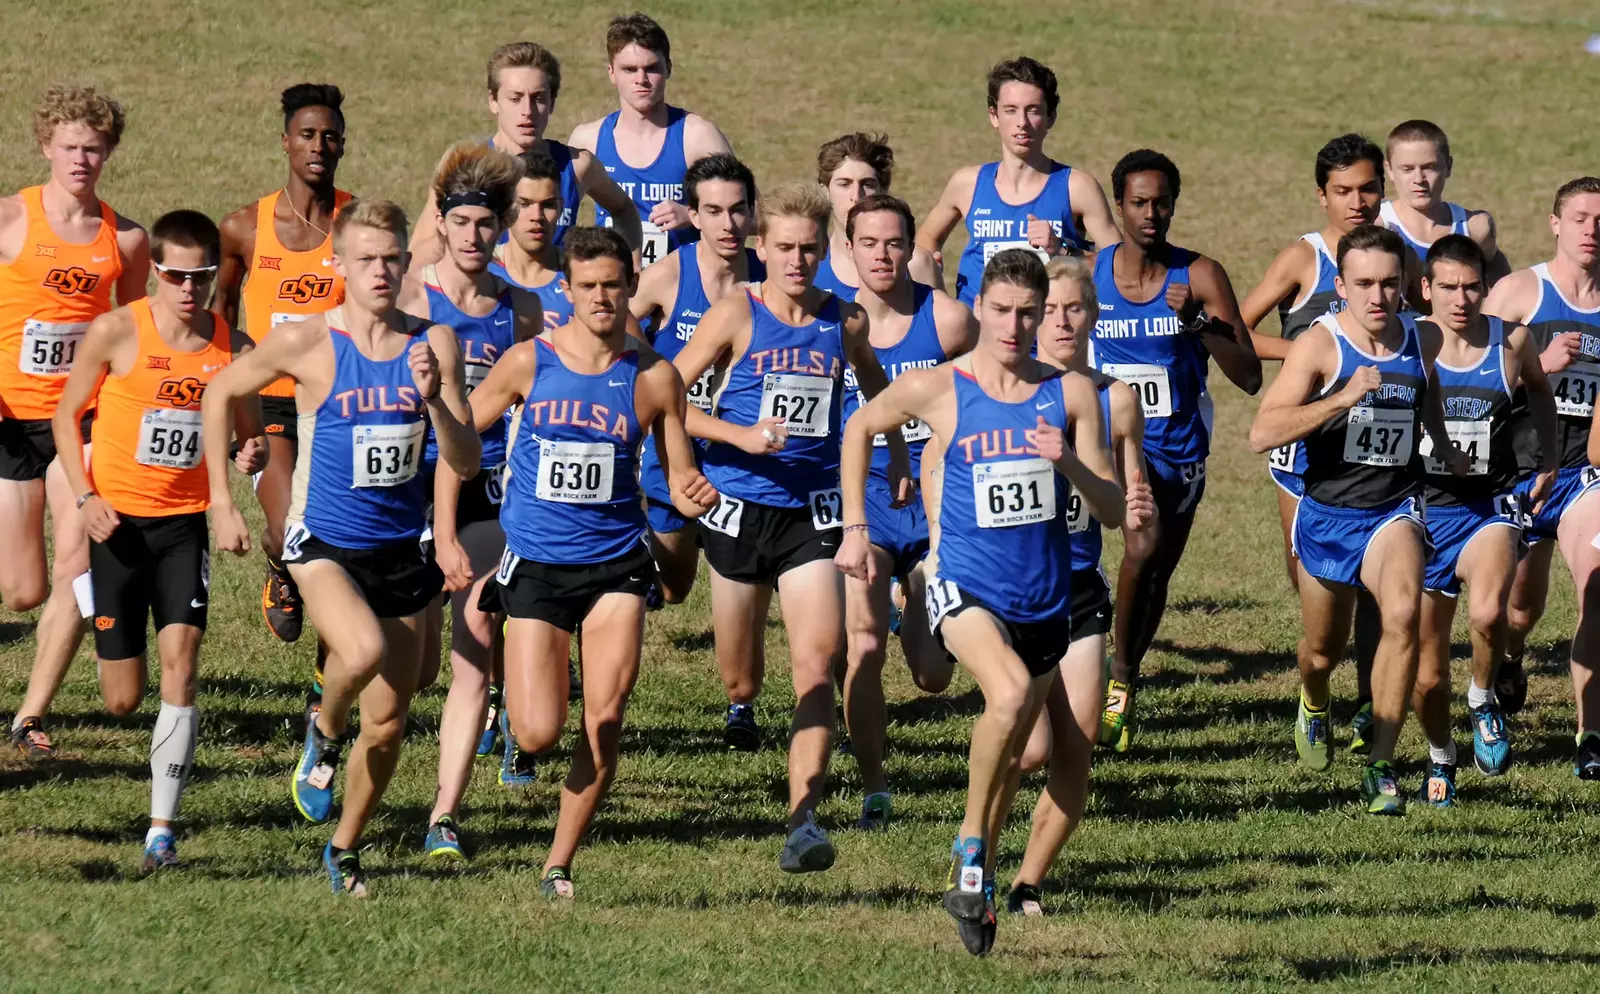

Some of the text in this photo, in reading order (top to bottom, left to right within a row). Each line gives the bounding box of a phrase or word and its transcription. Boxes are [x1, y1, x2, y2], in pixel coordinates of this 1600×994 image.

[641, 183, 683, 200] LOUIS
[974, 220, 1014, 237] SAINT
[43, 267, 99, 294] OSU
[278, 274, 333, 303] OSU
[1095, 319, 1138, 338] SAINT
[32, 340, 77, 366] 581
[750, 348, 840, 380] TULSA
[335, 386, 418, 417] TULS
[1555, 377, 1597, 406] 431
[529, 399, 628, 442] TULSA
[772, 394, 819, 424] 627
[149, 428, 198, 457] 584
[957, 429, 1041, 463] TULS
[1356, 427, 1404, 455] 437
[367, 444, 414, 474] 634
[549, 461, 600, 490] 630
[988, 481, 1042, 514] 631
